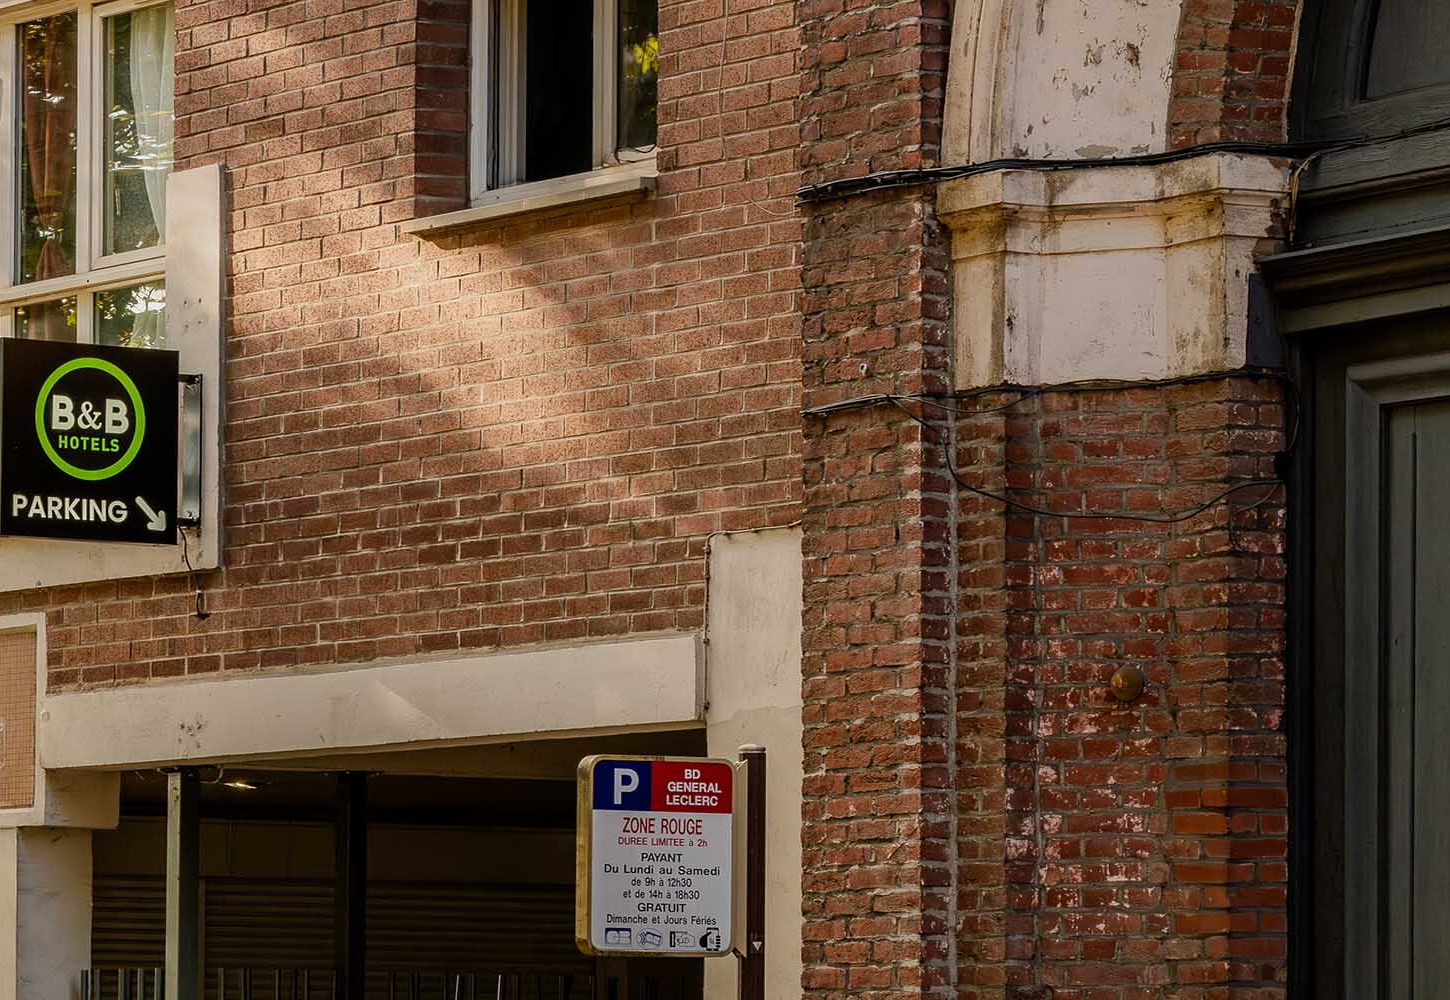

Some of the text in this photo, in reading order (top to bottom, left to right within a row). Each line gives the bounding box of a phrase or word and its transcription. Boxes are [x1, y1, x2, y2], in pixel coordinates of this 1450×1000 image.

[51, 394, 129, 434] B&B
[58, 435, 120, 453] HOTELS
[12, 494, 128, 523] PARKING
[684, 769, 701, 780] BD
[613, 768, 640, 805] P
[667, 781, 722, 793] GENERAL
[666, 794, 719, 807] LECLERC
[622, 817, 703, 835] ZONE ROUGE
[618, 837, 648, 846] DUREE
[651, 837, 685, 847] LIMITEE
[697, 838, 708, 848] 2h
[641, 853, 683, 863] PAYANT
[604, 863, 619, 874] Du
[623, 864, 654, 875] Lundi
[677, 865, 721, 877] Samedi
[631, 877, 642, 887] de
[644, 877, 656, 887] 9h
[668, 878, 693, 888] 12h30
[622, 890, 632, 899] et
[634, 890, 646, 899] de
[649, 890, 663, 899] 14h
[675, 890, 700, 900] 18h30
[637, 902, 687, 913] GRATUIT
[606, 913, 648, 924] Dimanche
[652, 915, 661, 924] et
[663, 915, 688, 925] Jours
